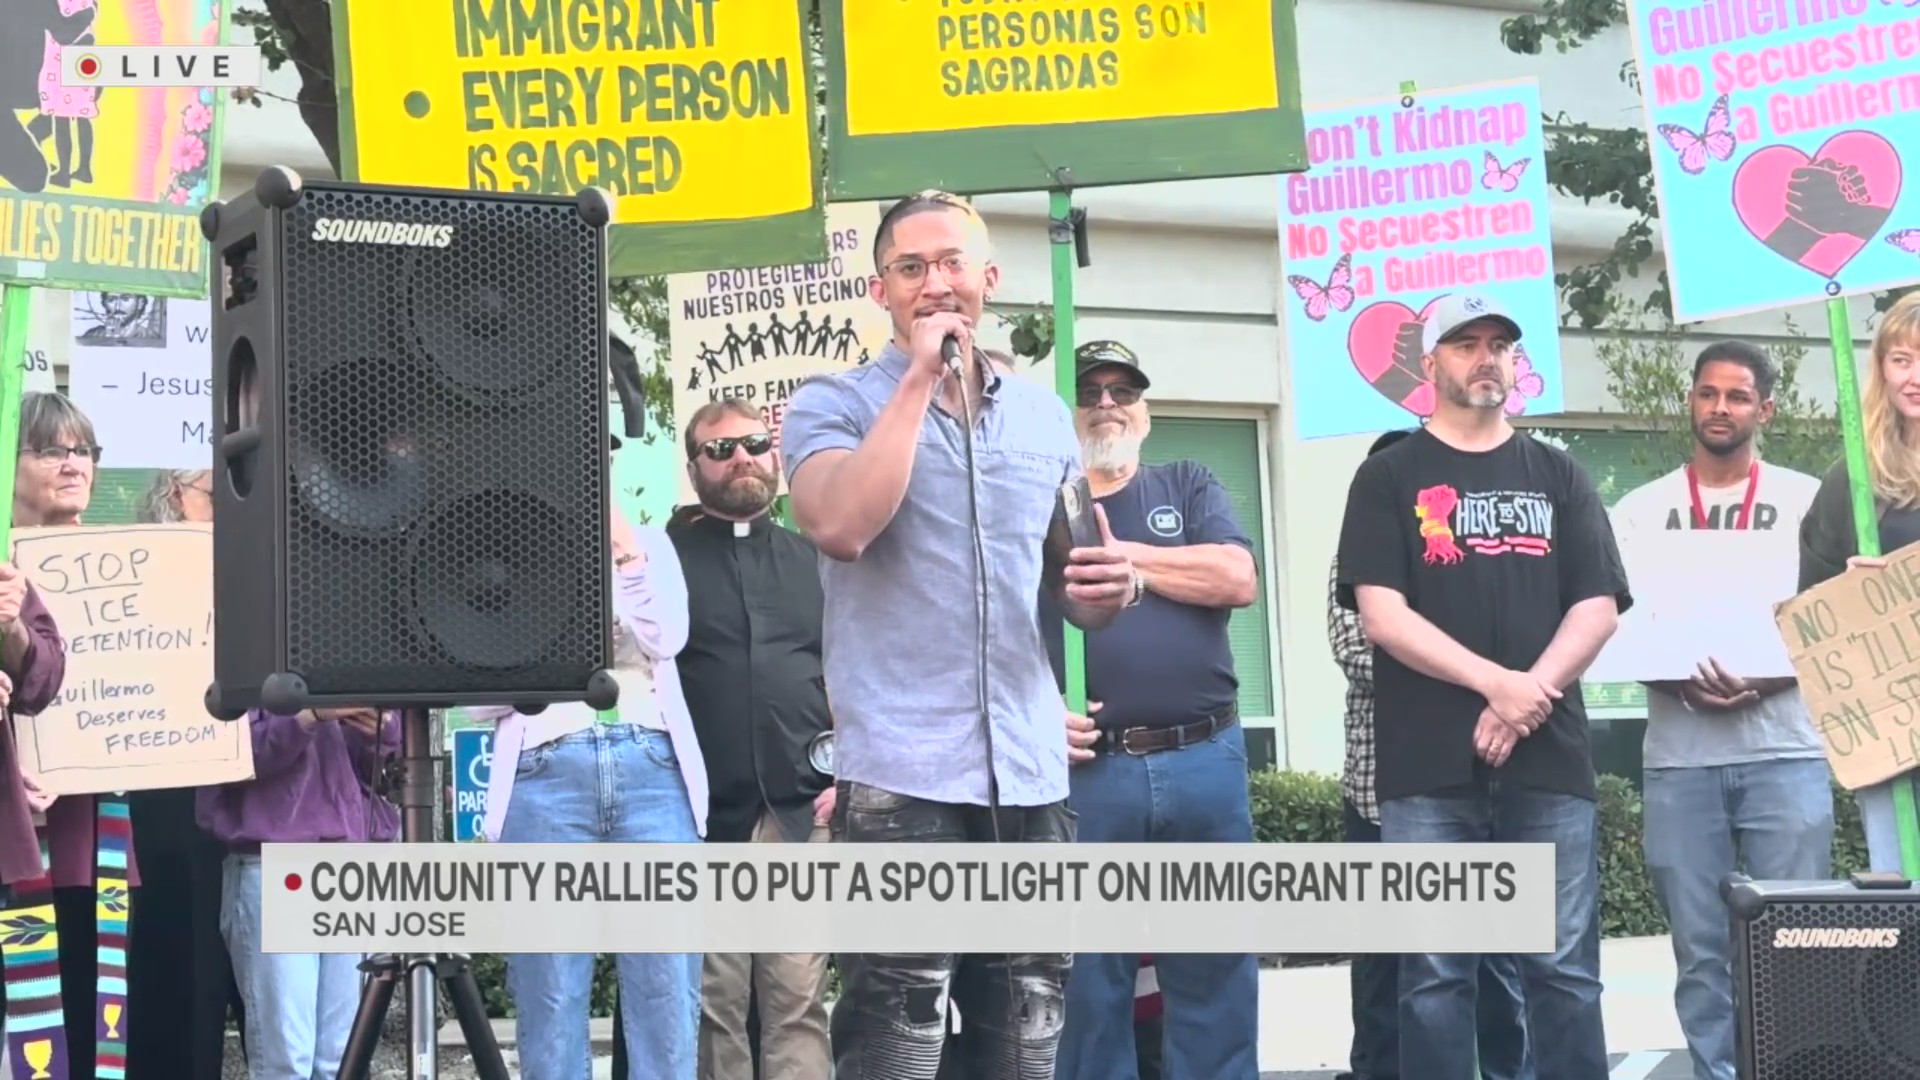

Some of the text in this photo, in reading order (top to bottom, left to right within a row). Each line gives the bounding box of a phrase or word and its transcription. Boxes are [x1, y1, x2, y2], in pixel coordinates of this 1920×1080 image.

[452, 0, 720, 57] IMMIGRANT
[938, 2, 1207, 51] PERSONAS SON
[941, 50, 1119, 97] SAGRADAS
[1653, 18, 1920, 106] No Secuestre
[463, 57, 790, 131] EVERY PERSON
[1735, 73, 1920, 143] a Guillerm
[1307, 101, 1527, 164] on't Kidnap
[468, 136, 682, 195] IS SACRED
[1287, 158, 1474, 216] Guillermo
[71, 204, 200, 273] TOGETHER
[312, 218, 454, 248] SOUNDBOKS
[1287, 200, 1534, 259] No Secuestren
[707, 256, 843, 294] PROTEGIENDO
[1355, 246, 1548, 297] a Guillermo
[684, 275, 876, 320] NUESTROS VECINO
[137, 371, 214, 396] Jesus
[1456, 496, 1553, 540] HERE TO STAY
[37, 548, 150, 593] STOP
[84, 593, 139, 626] ICE
[1792, 554, 1920, 649] NO ONE
[1811, 650, 1853, 695] IS
[77, 708, 166, 730] Deserves
[106, 725, 216, 755] FREEDOM
[1820, 697, 1880, 757] ON
[1773, 928, 1900, 948] SOUNDBOKS
